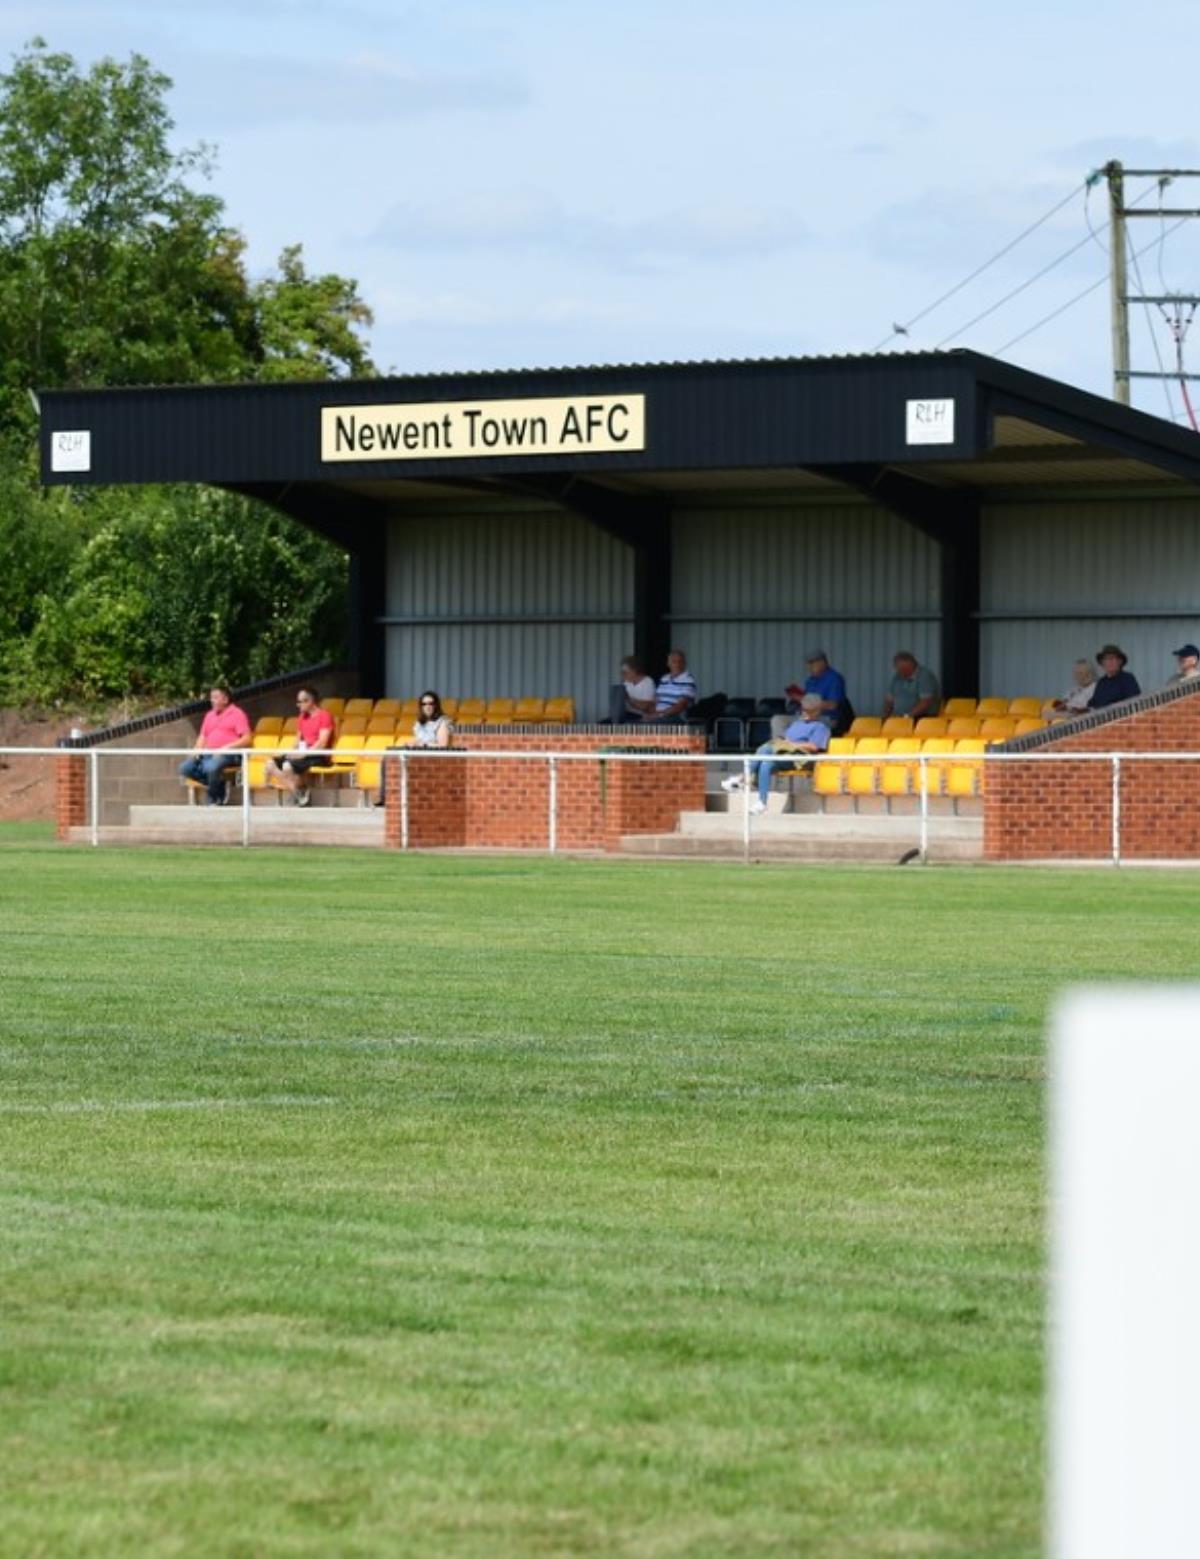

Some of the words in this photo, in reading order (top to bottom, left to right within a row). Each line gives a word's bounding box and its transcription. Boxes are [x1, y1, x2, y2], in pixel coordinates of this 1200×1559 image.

[334, 413, 453, 452] Newent
[462, 410, 548, 448] Town
[558, 402, 630, 444] AFC
